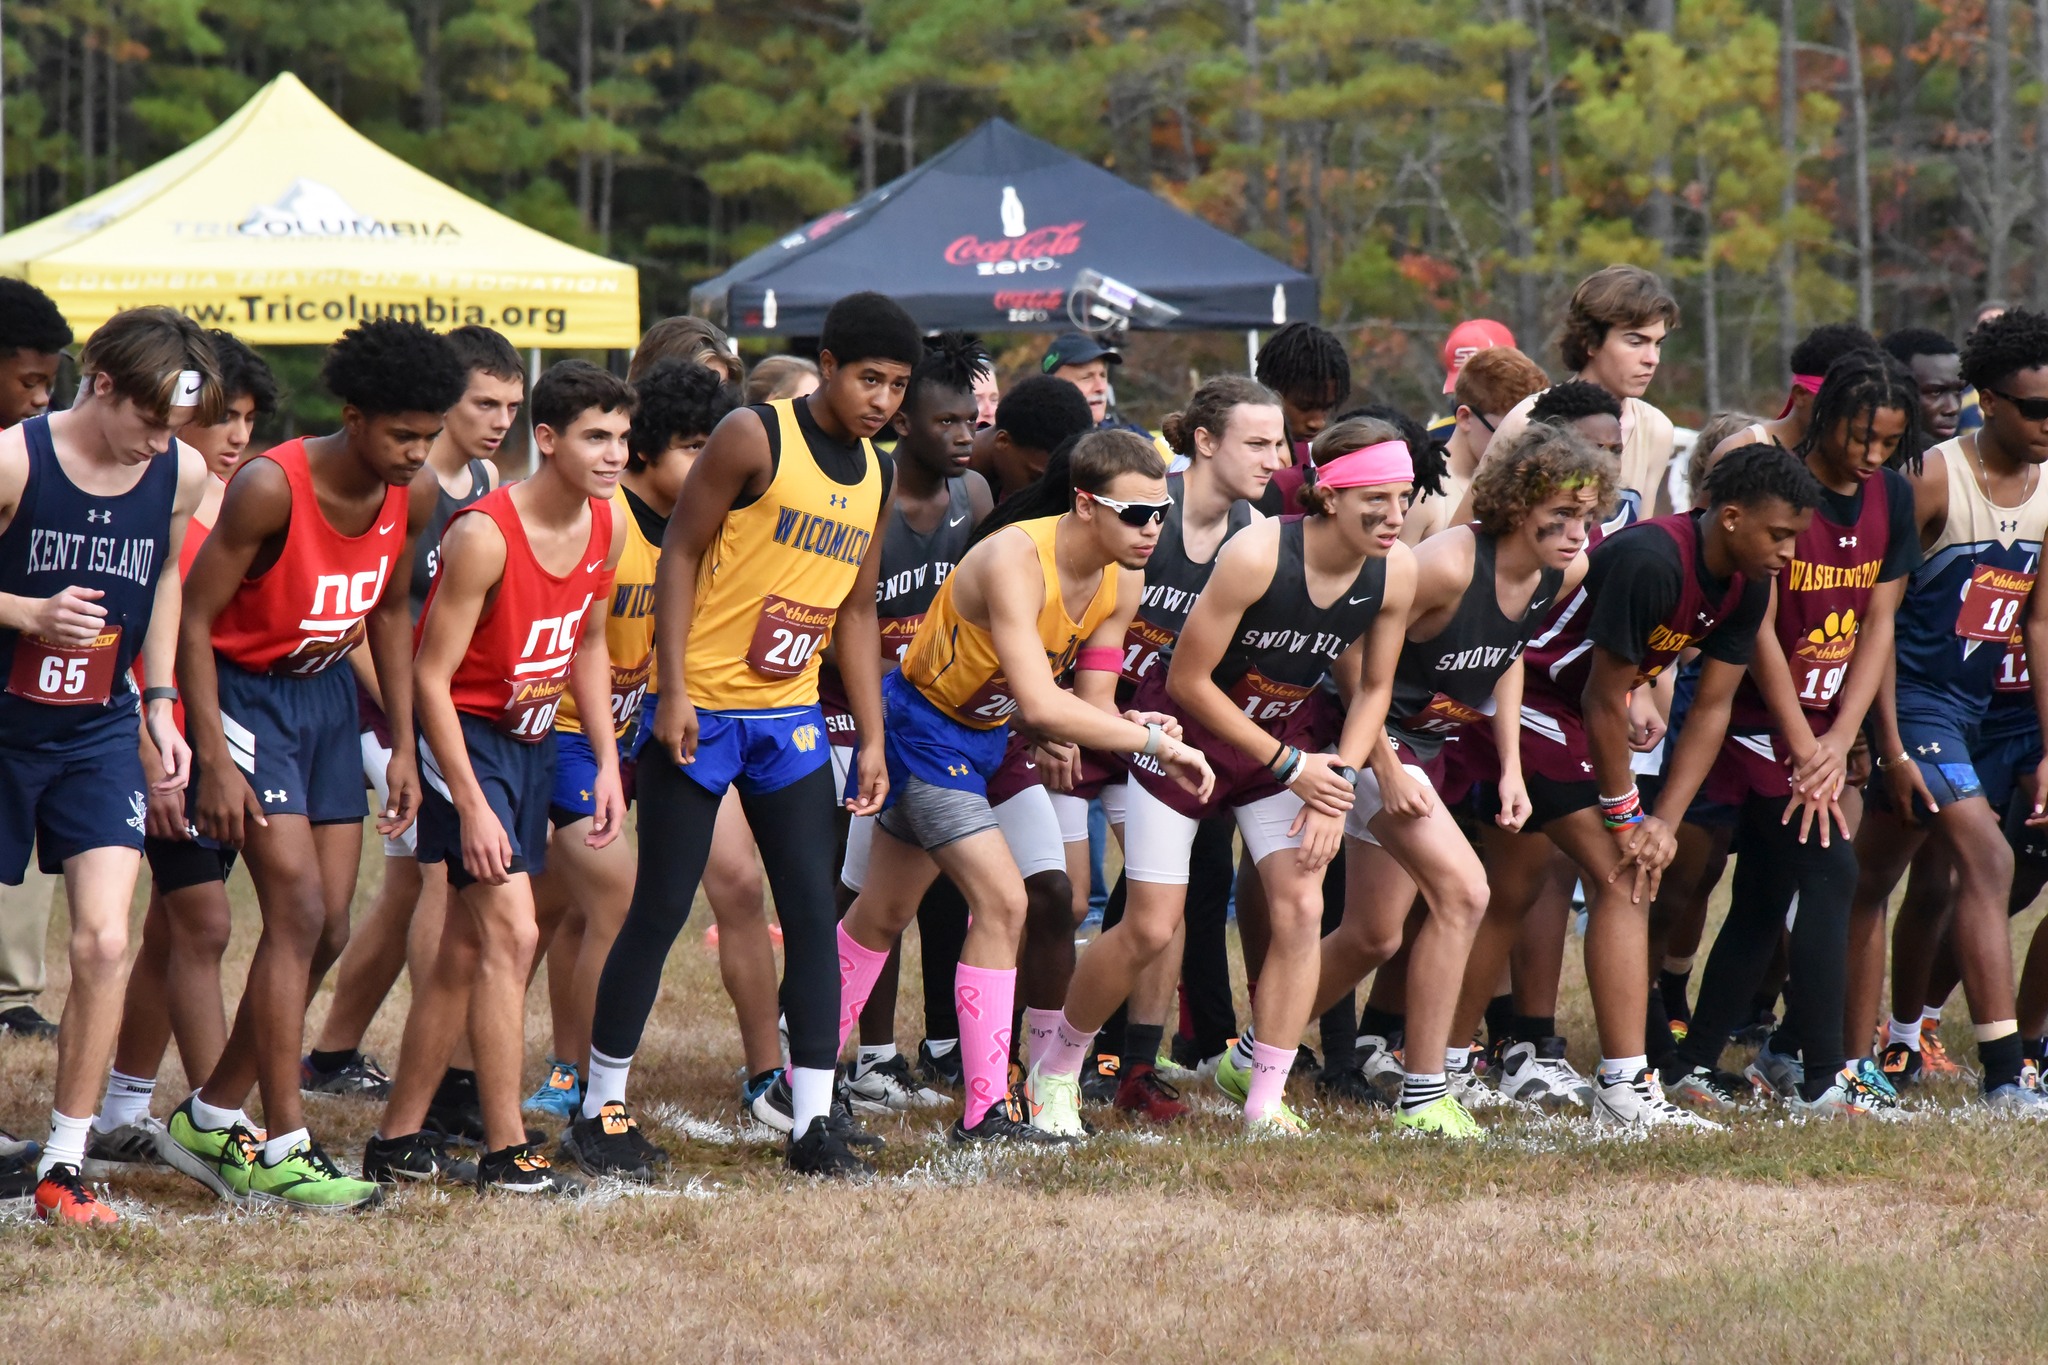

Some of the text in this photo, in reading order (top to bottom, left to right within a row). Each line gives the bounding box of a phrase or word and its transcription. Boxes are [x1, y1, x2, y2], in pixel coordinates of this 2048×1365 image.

[58, 271, 218, 291] COLUMBIA
[420, 271, 619, 293] ASSOCIATION
[117, 294, 566, 334] w.Tricolumbia.org
[27, 529, 154, 586] KENT ISLAND
[1983, 598, 2019, 632] 18
[1241, 629, 1311, 653] SNOW
[38, 656, 89, 694] 65
[1435, 646, 1507, 671] SNOW
